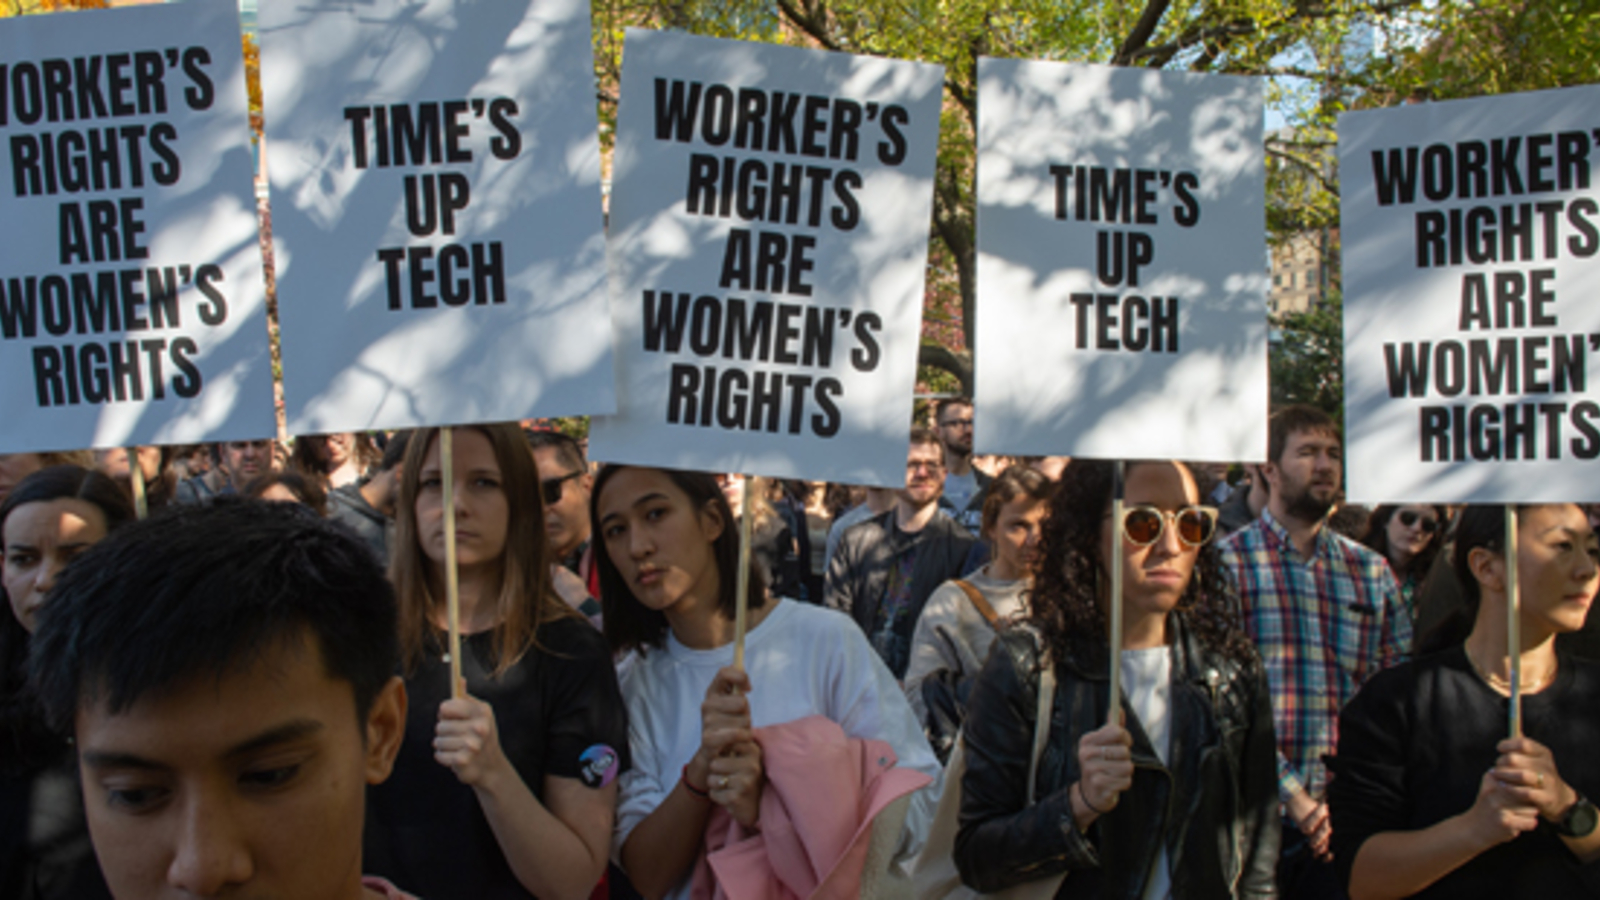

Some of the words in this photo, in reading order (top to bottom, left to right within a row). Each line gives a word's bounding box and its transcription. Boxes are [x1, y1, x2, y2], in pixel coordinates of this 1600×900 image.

[343, 97, 522, 170] TIME'S
[653, 76, 910, 167] WORKER'S
[9, 121, 181, 198] RIGHTS
[686, 152, 864, 233] RIGHTS
[58, 196, 149, 266] ARE
[403, 172, 470, 237] UP
[1048, 164, 1201, 228] TIME'S
[718, 228, 818, 297] ARE
[1095, 229, 1155, 288] UP
[1414, 199, 1599, 269] RIGHTS
[0, 264, 226, 340] WOMEN'S
[377, 240, 506, 312] TECH
[1458, 270, 1557, 330] ARE
[642, 289, 882, 372] WOMEN'S
[1070, 292, 1180, 354] TECH
[31, 336, 203, 408] RIGHTS
[666, 363, 843, 440] RIGHTS
[1419, 402, 1600, 463] RIGHTS
